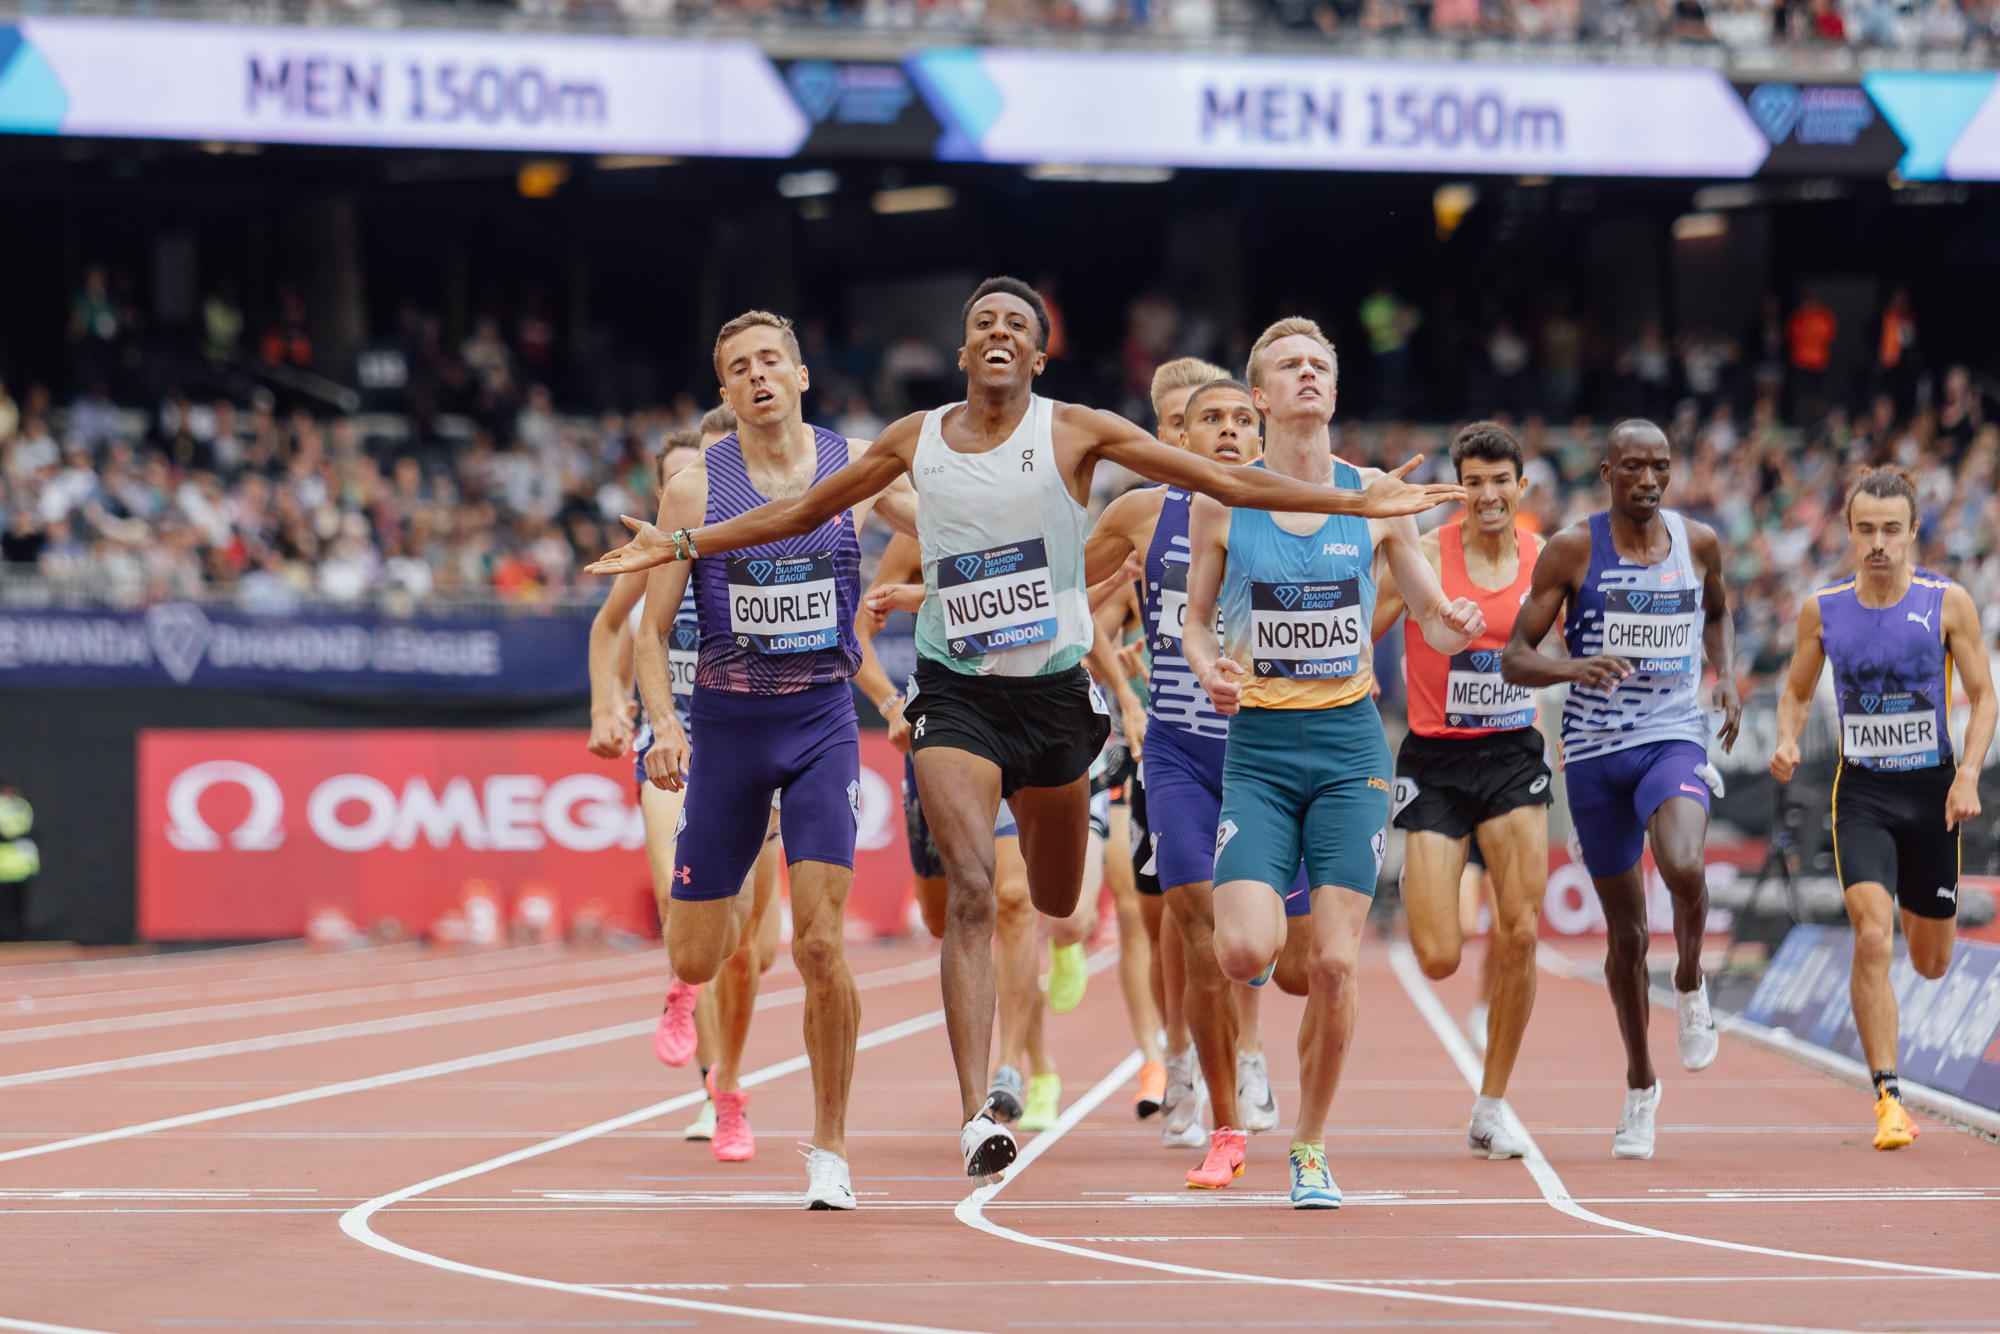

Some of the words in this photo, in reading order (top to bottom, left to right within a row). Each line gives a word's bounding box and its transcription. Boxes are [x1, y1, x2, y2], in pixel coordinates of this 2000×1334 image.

[247, 58, 384, 117] MEN
[406, 63, 608, 125] 1500m
[1200, 88, 1342, 145] MEN
[1366, 93, 1564, 150] 1500m
[923, 466, 945, 475] OAC
[1322, 543, 1360, 558] HOKA
[985, 553, 1024, 568] DIAMOND
[775, 563, 813, 575] DIAMOND
[984, 563, 1017, 577] LEAGUE
[774, 572, 807, 583] LEAGUE
[947, 580, 1049, 626] NUGUSE
[1303, 591, 1342, 601] DIAMOND
[735, 590, 832, 624] GOURLEY
[1301, 600, 1335, 609] LEAGUE
[987, 625, 1044, 647] LONDON
[1258, 615, 1358, 649] NORDÅS
[1608, 623, 1691, 648] CHERUIYOT
[770, 633, 825, 650] LONDON
[1295, 660, 1352, 675] LONDON
[1640, 659, 1684, 672] LONDON
[1452, 681, 1531, 706] MECHAAL
[1482, 712, 1526, 728] LONDON
[1848, 720, 1933, 748] TANNER
[1879, 755, 1926, 768] LONDON
